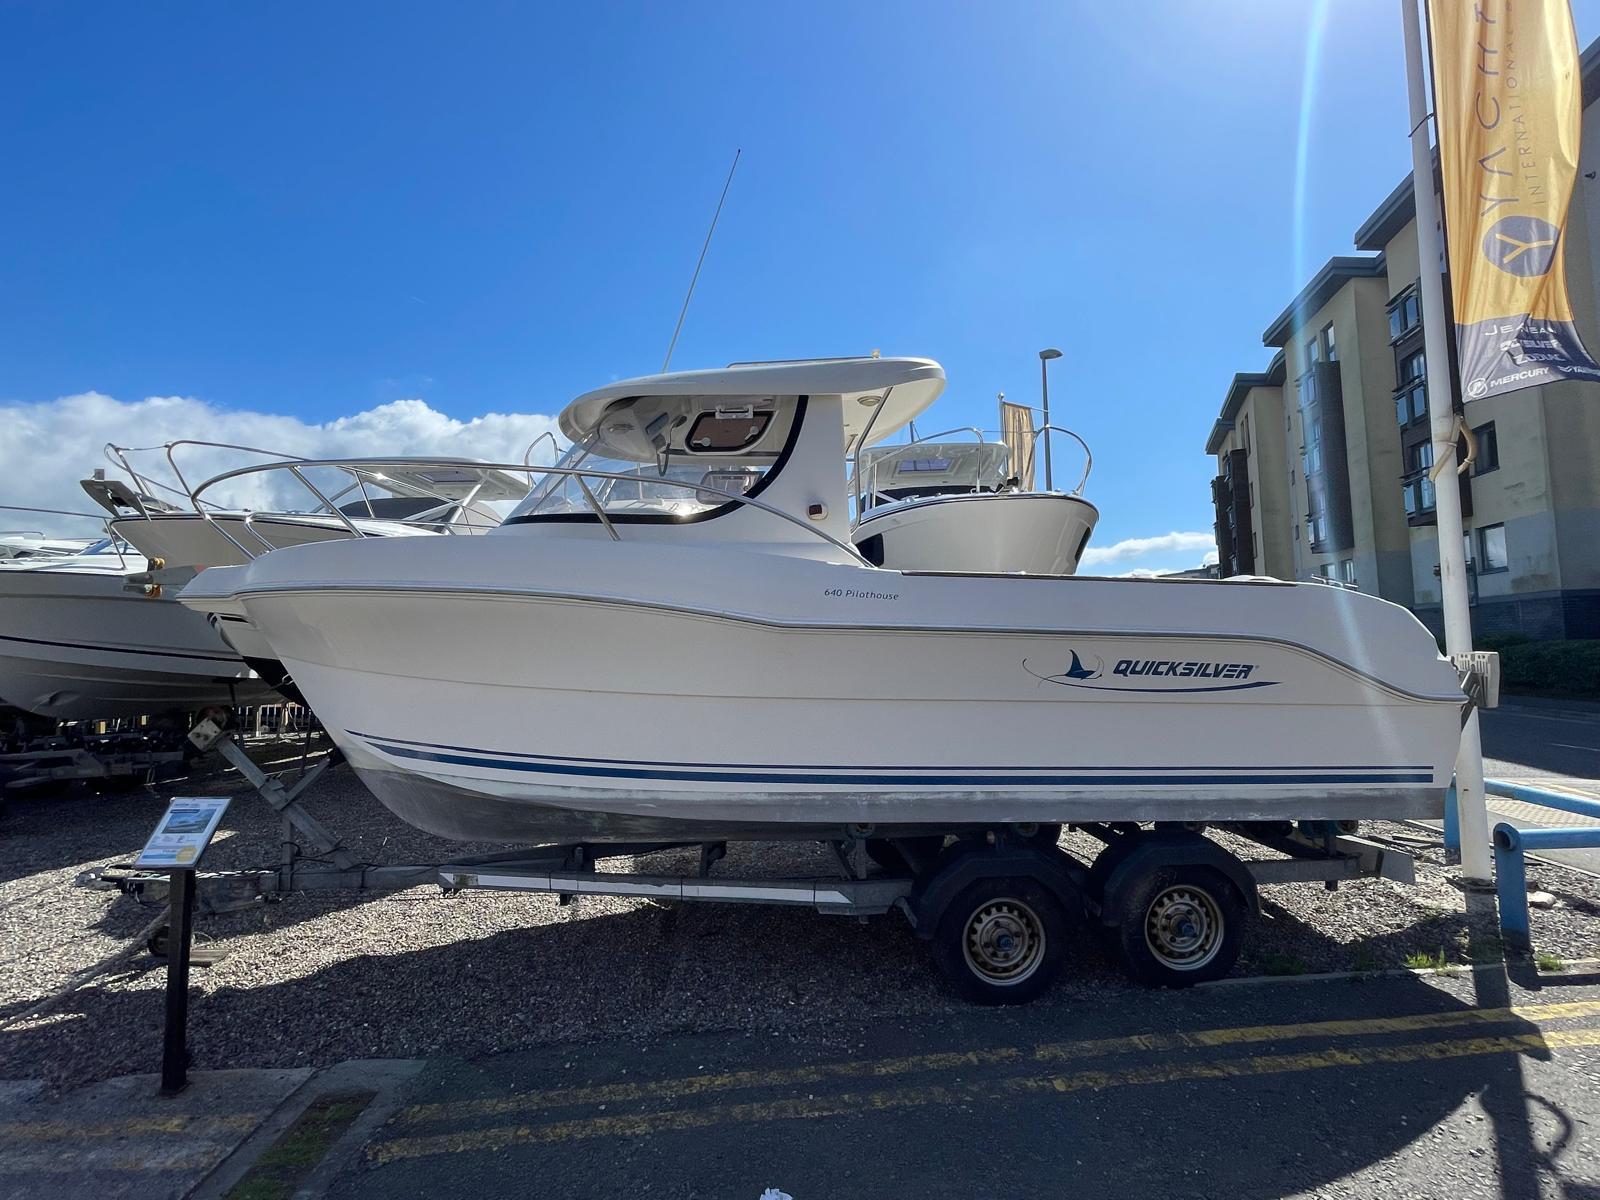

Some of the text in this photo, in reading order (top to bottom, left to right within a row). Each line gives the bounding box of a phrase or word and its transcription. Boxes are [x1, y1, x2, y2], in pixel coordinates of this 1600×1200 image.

[1474, 3, 1520, 216] YACHT
[1490, 367, 1550, 387] MERCURY
[824, 588, 899, 600] 640 Pilothouse
[1113, 659, 1254, 679] QUICKSILVER
